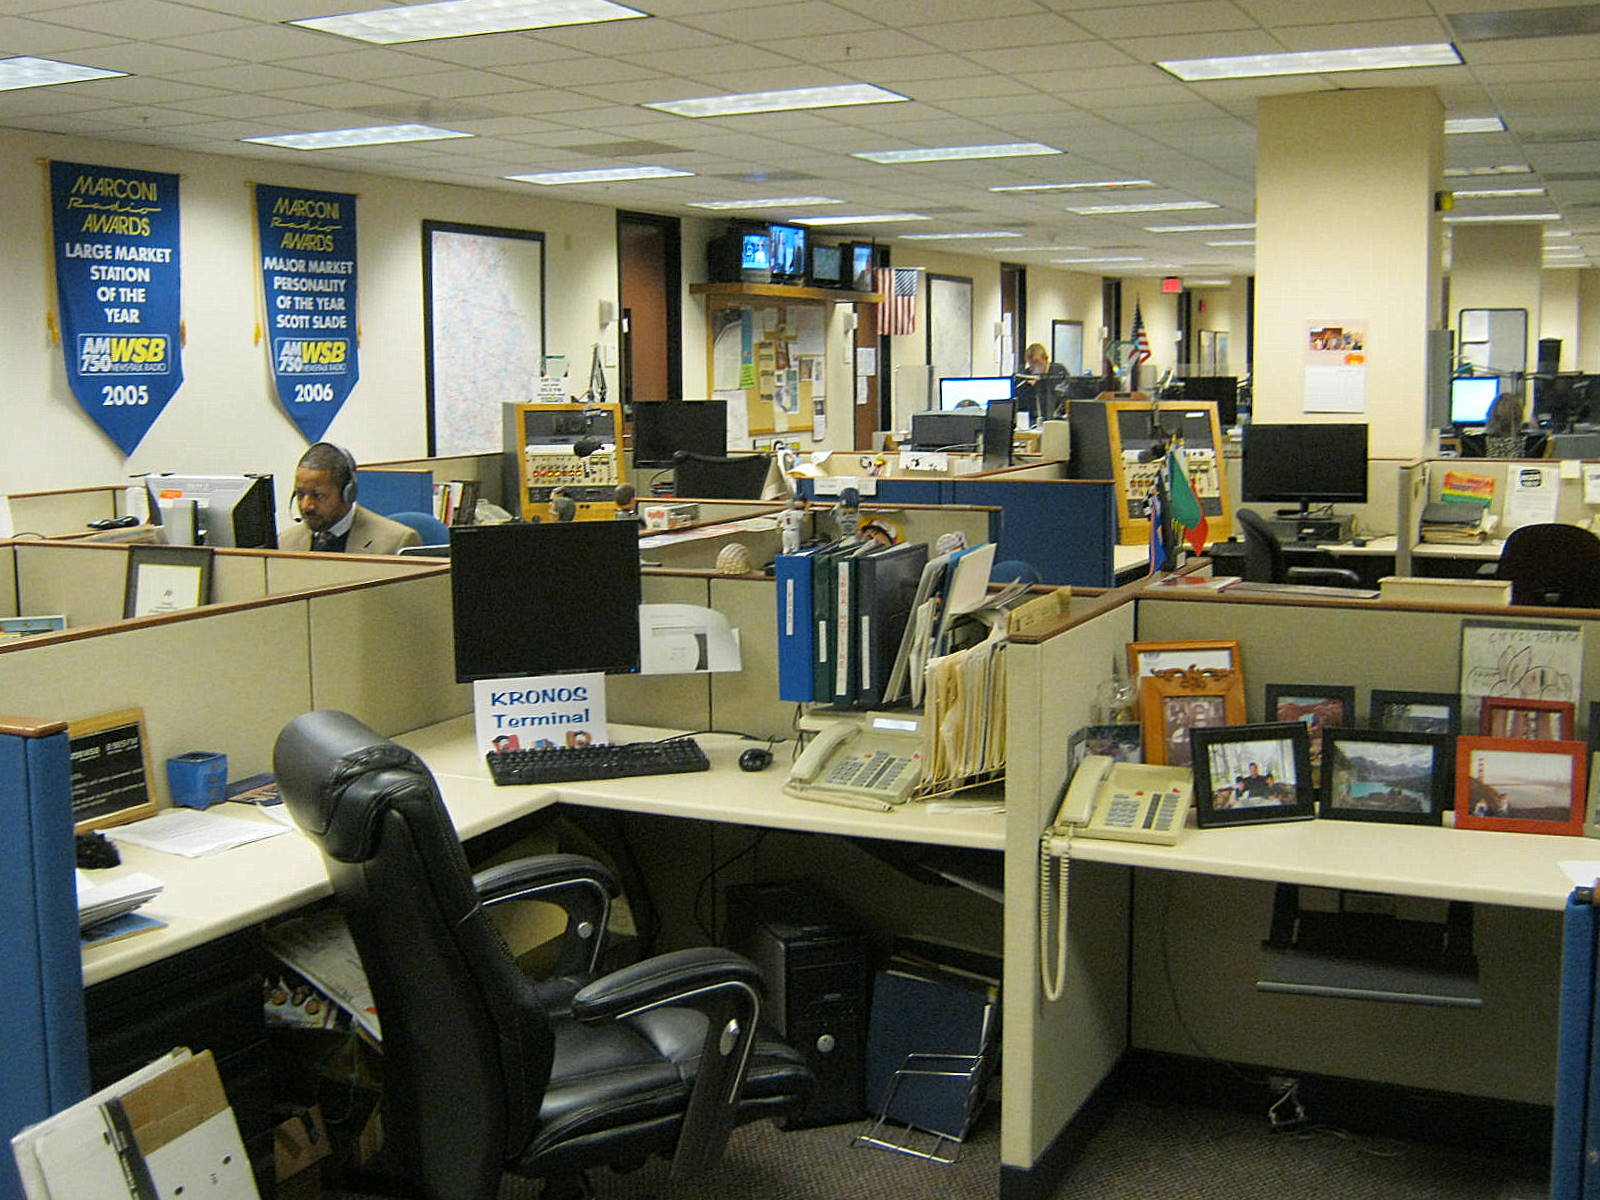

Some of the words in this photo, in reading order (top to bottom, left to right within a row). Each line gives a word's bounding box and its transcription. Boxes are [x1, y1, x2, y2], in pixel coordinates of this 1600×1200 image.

[72, 177, 156, 201] MARCONI
[67, 198, 161, 214] Radio
[273, 198, 339, 219] MARCONI
[81, 214, 150, 235] AWARDS
[281, 232, 334, 251] AWARDS
[66, 243, 112, 259] LARGE
[115, 246, 171, 262] MARKET
[90, 265, 150, 282] STATION
[264, 257, 305, 272] MAJOR
[308, 260, 354, 274] MARKET
[274, 277, 346, 292] PERSONALITY
[97, 286, 116, 302] OF
[119, 287, 146, 303] THE
[277, 294, 291, 309] OF
[294, 296, 314, 311] THE
[316, 297, 346, 311] YEAR
[104, 308, 140, 323] YEAR
[276, 313, 309, 329] SCOTT
[312, 315, 347, 329] SLADE
[82, 337, 111, 355] AM
[112, 337, 165, 363] WSB
[280, 341, 303, 357] AM
[302, 341, 346, 364] WSB
[80, 354, 112, 372] 750
[278, 355, 303, 373] 750
[102, 385, 148, 406] 2005
[295, 384, 334, 403] 2006
[491, 687, 589, 706] KRONOS
[492, 709, 590, 728] Terminal
